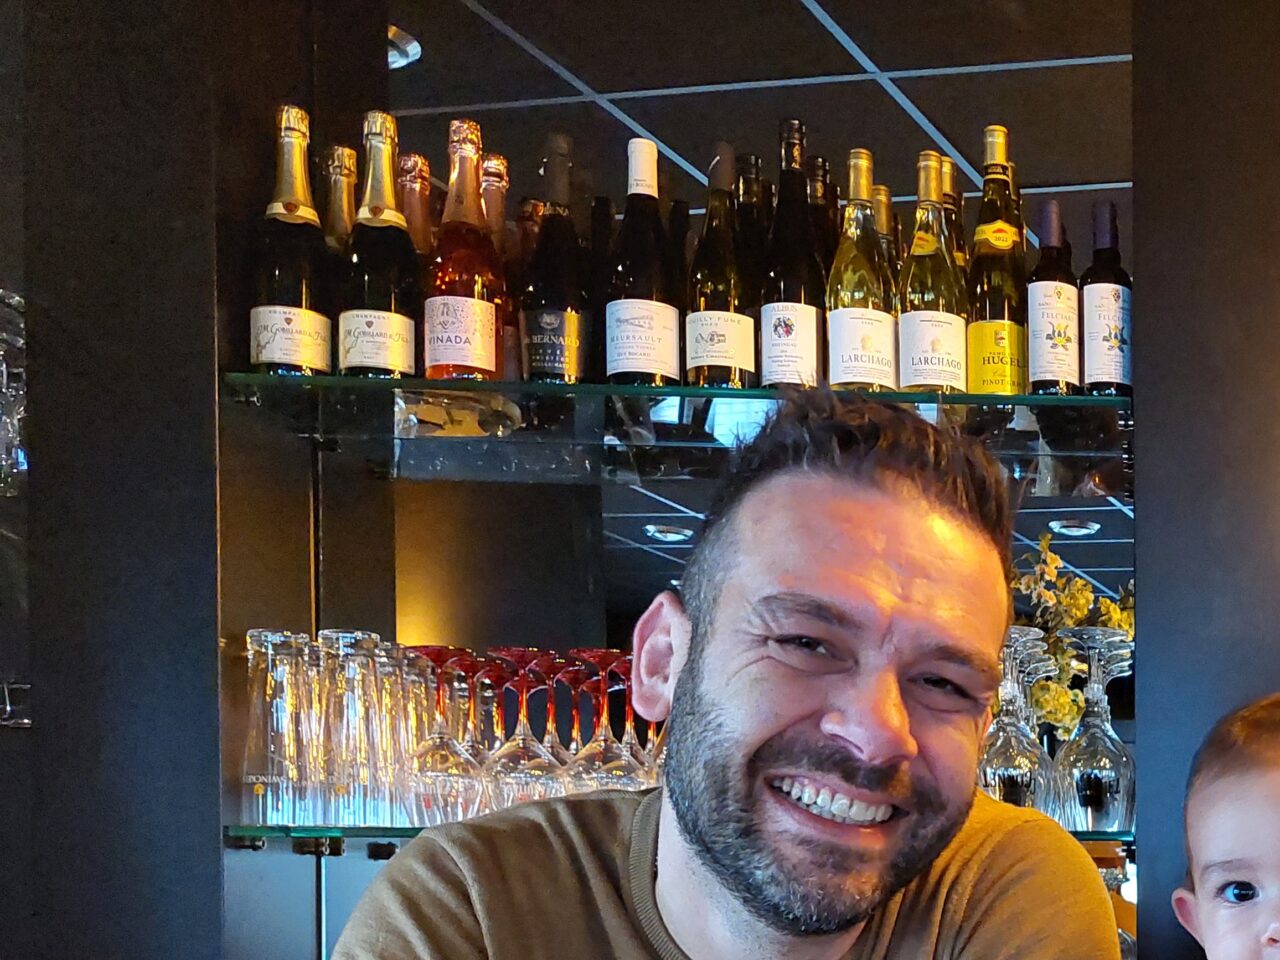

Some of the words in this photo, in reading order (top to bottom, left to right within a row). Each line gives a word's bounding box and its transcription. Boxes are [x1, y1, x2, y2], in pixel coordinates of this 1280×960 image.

[427, 335, 472, 346] VINADA
[841, 353, 892, 369] LARCHAGO
[911, 356, 962, 371] LARCHAGO
[982, 356, 1022, 368] HUGEL
